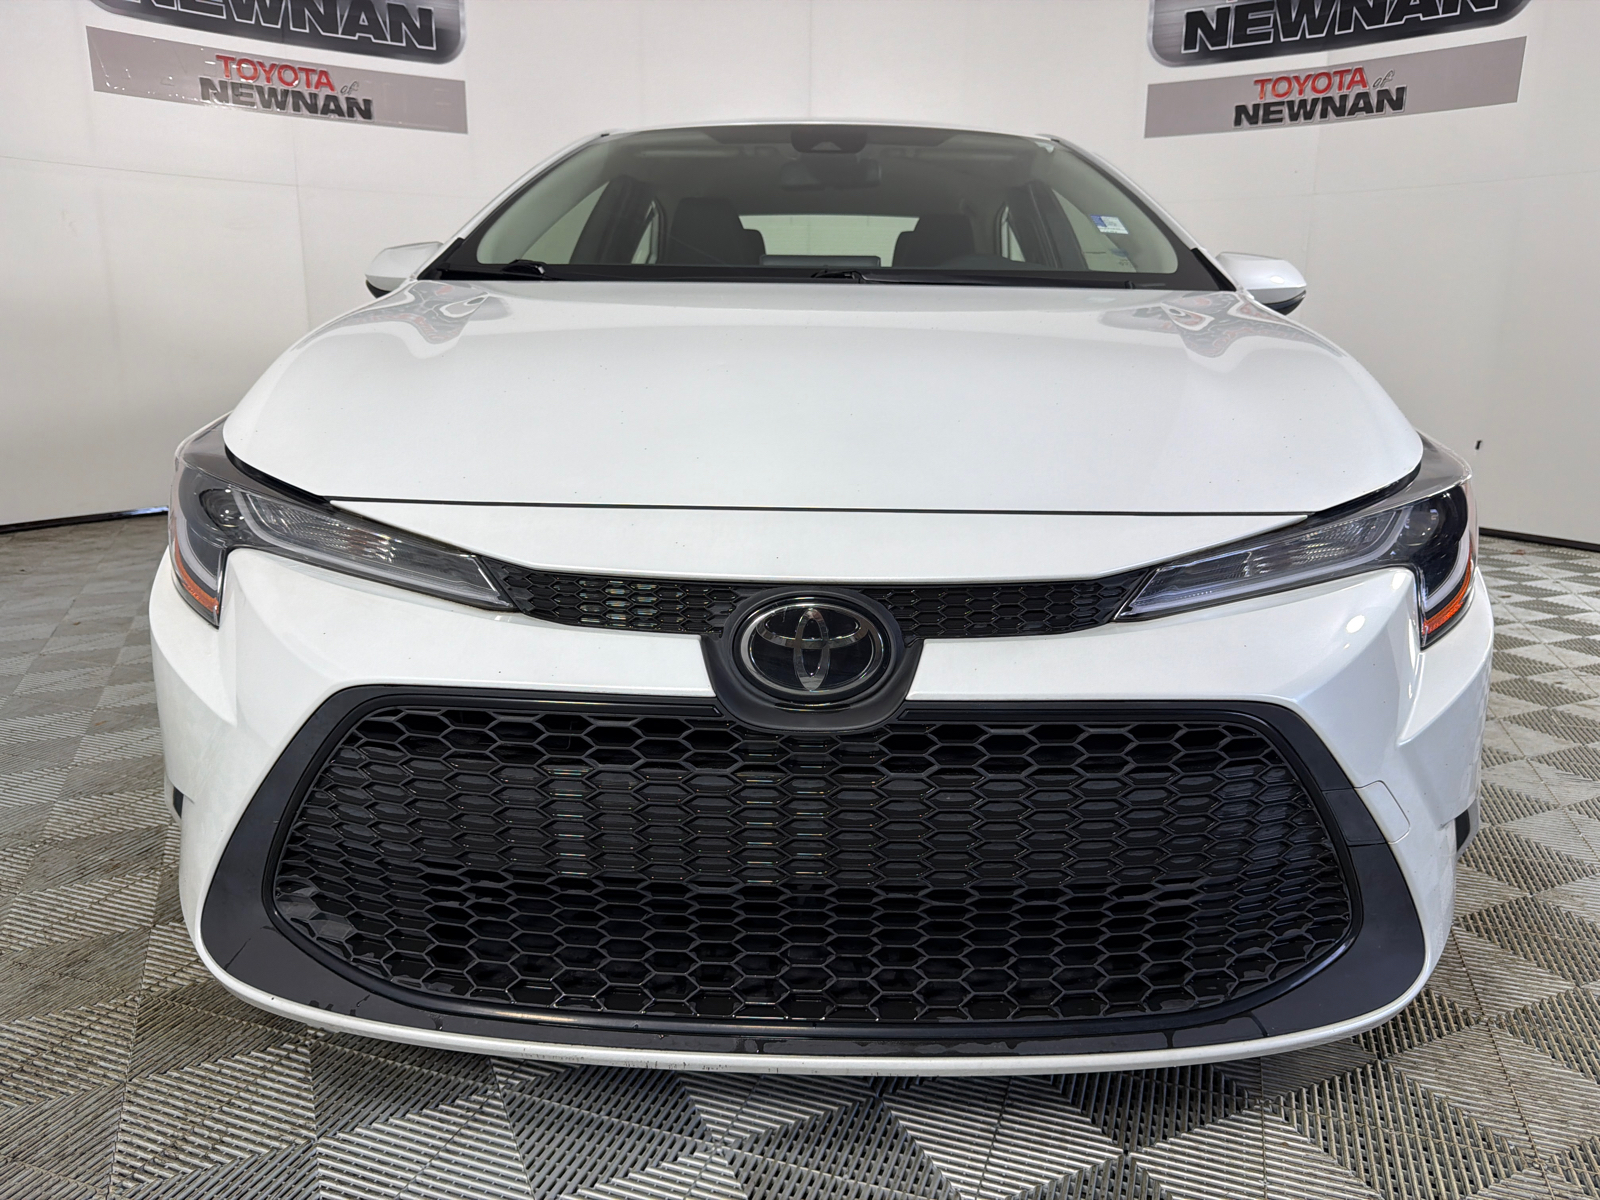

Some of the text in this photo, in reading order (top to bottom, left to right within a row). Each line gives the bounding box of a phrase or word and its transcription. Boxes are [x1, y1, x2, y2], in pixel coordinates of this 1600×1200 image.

[123, 0, 436, 50] WNAN
[1181, 0, 1499, 54] NEWN
[216, 55, 359, 95] TOYOTA of
[1254, 67, 1395, 99] TOYOTA of
[199, 77, 373, 120] NEWNAN
[1233, 86, 1406, 126] NEWNAN
